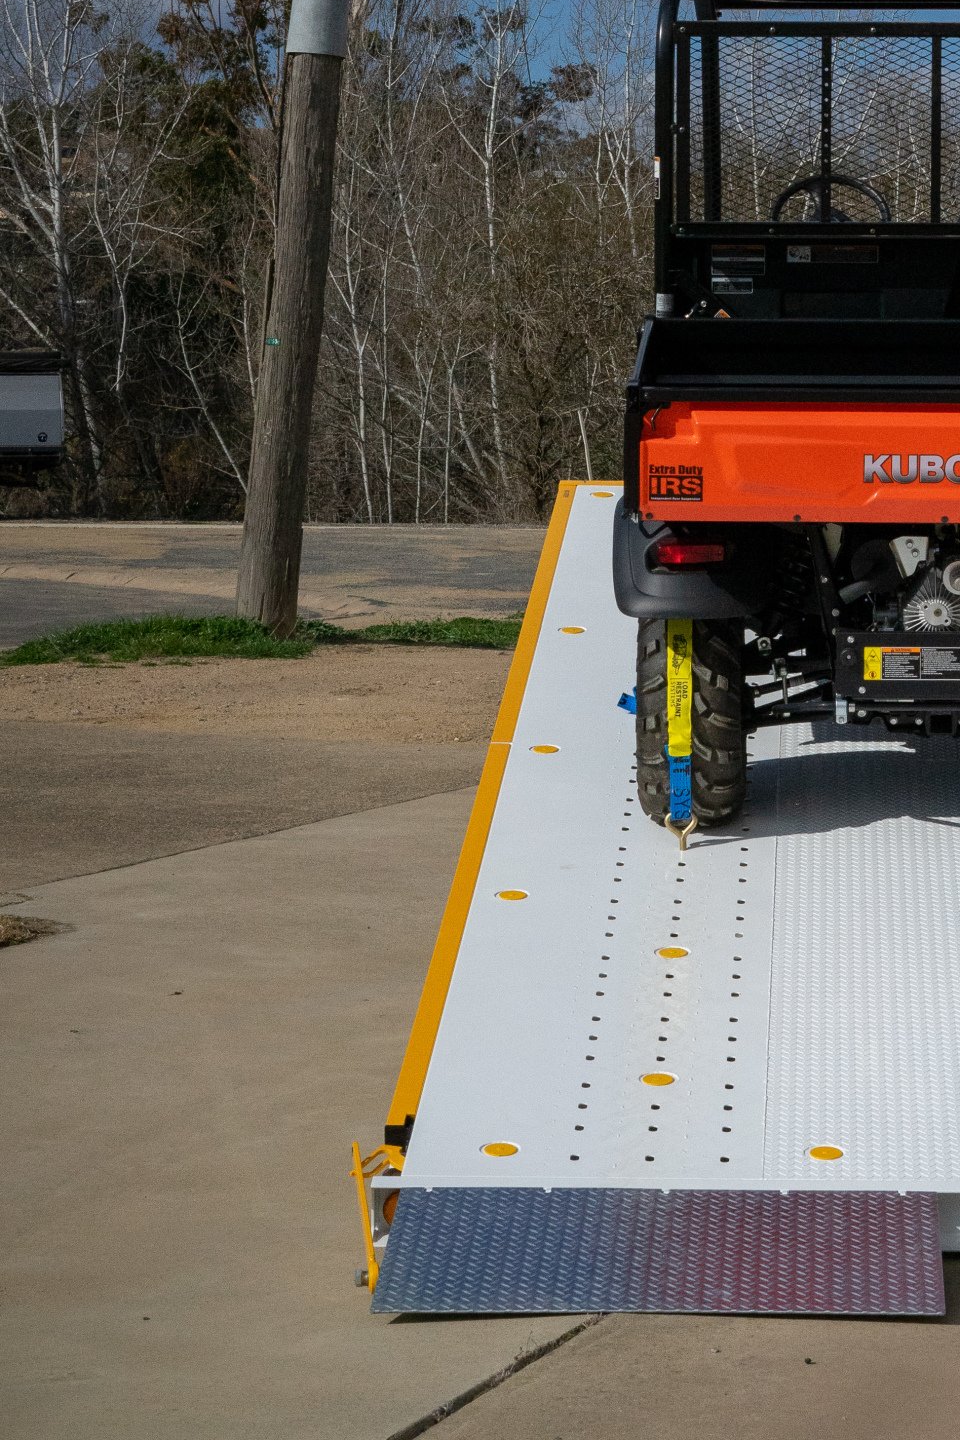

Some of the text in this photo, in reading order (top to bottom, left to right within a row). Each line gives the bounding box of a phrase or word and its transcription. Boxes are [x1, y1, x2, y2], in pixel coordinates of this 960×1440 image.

[649, 464, 703, 476] Extra Duty
[651, 477, 702, 495] IRS
